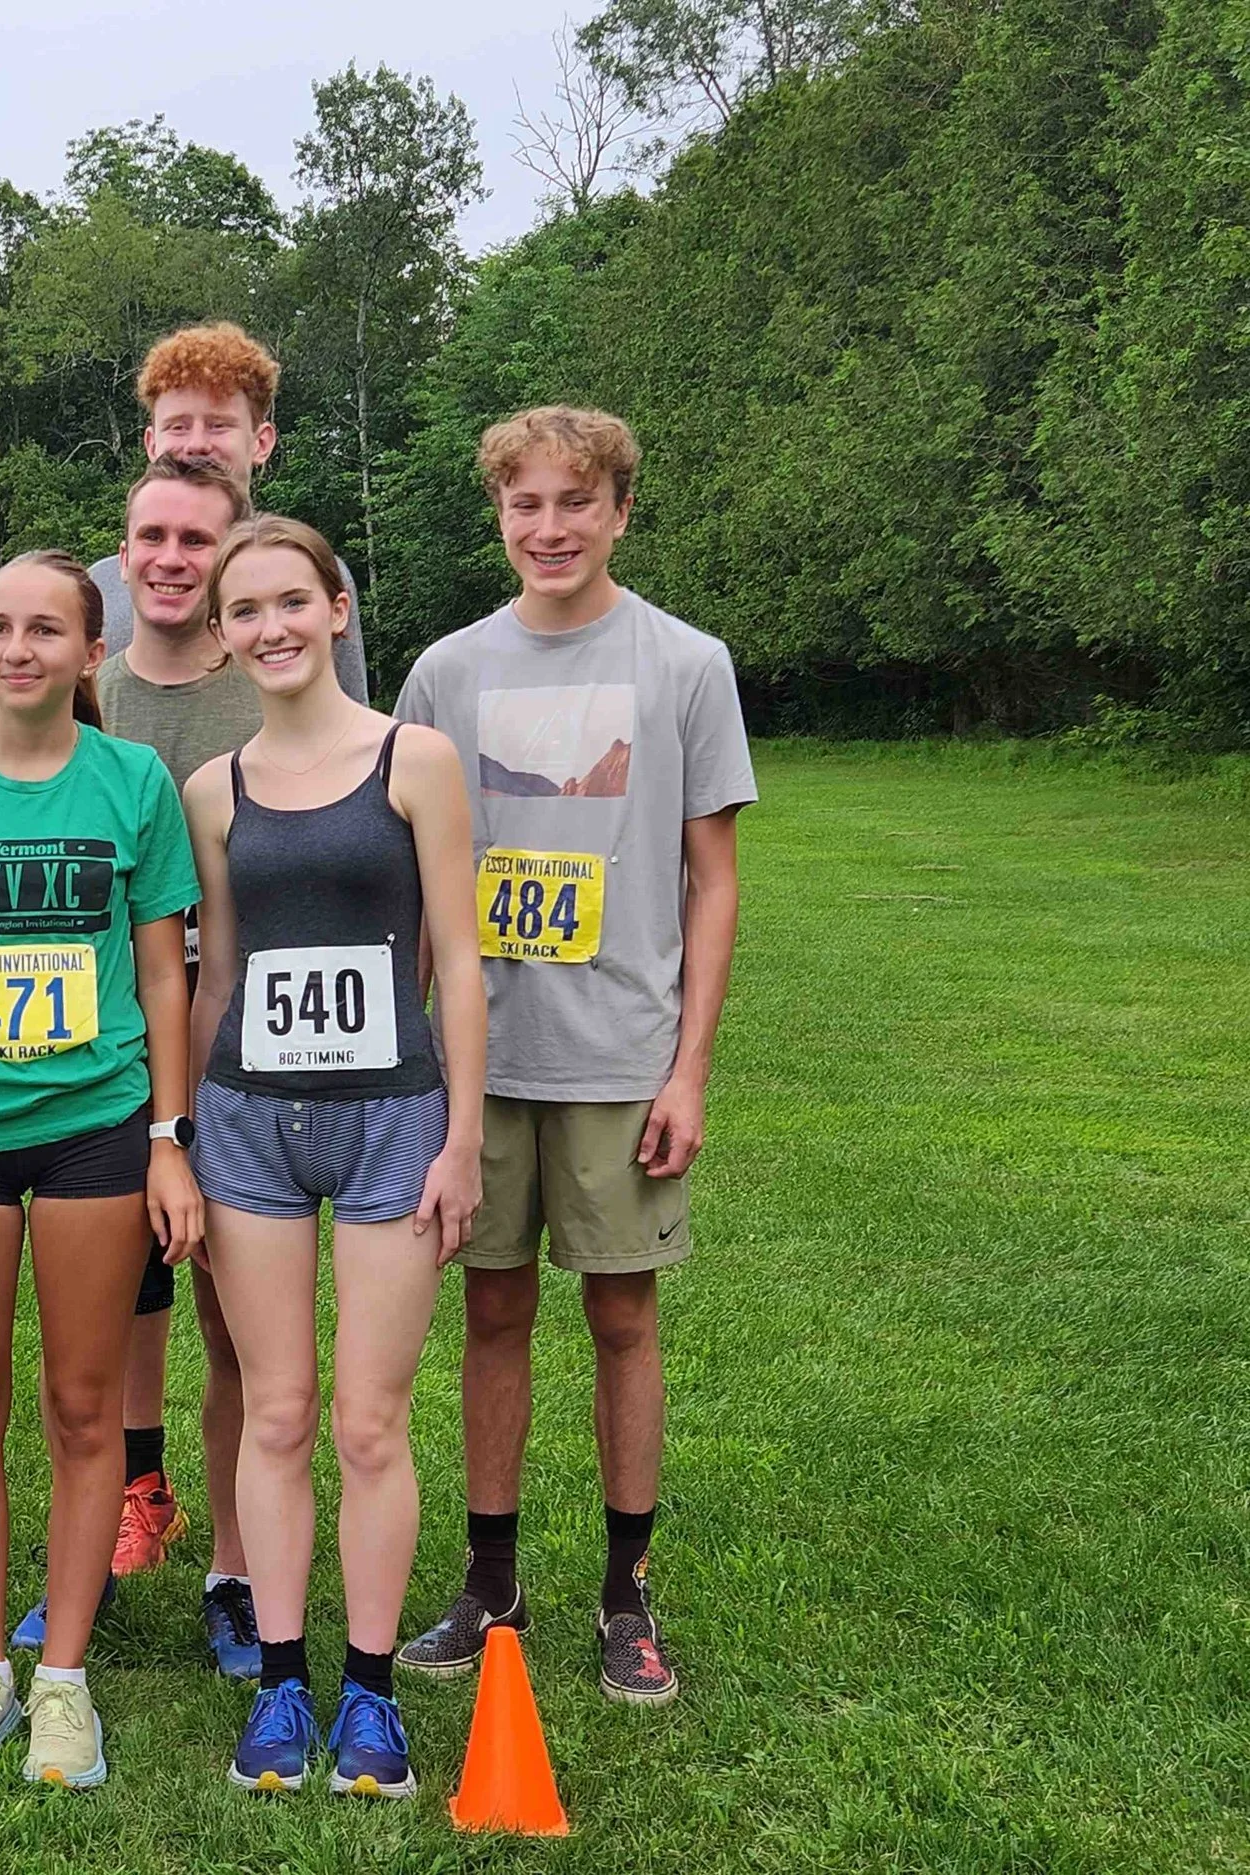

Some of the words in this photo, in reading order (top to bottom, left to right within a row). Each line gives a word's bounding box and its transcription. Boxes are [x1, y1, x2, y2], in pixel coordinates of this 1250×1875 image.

[486, 857, 513, 874] ESSEX
[516, 859, 594, 879] INVITATIONAL
[42, 862, 81, 909] XC
[488, 879, 579, 941] 484
[25, 919, 75, 928] Invitational
[500, 941, 518, 955] SKI
[522, 944, 559, 958] RACK
[0, 952, 85, 973] INVITATIONAL
[266, 968, 366, 1036] 540
[19, 1045, 57, 1059] RACK
[279, 1052, 302, 1065] 802
[305, 1050, 355, 1065] TIMING
